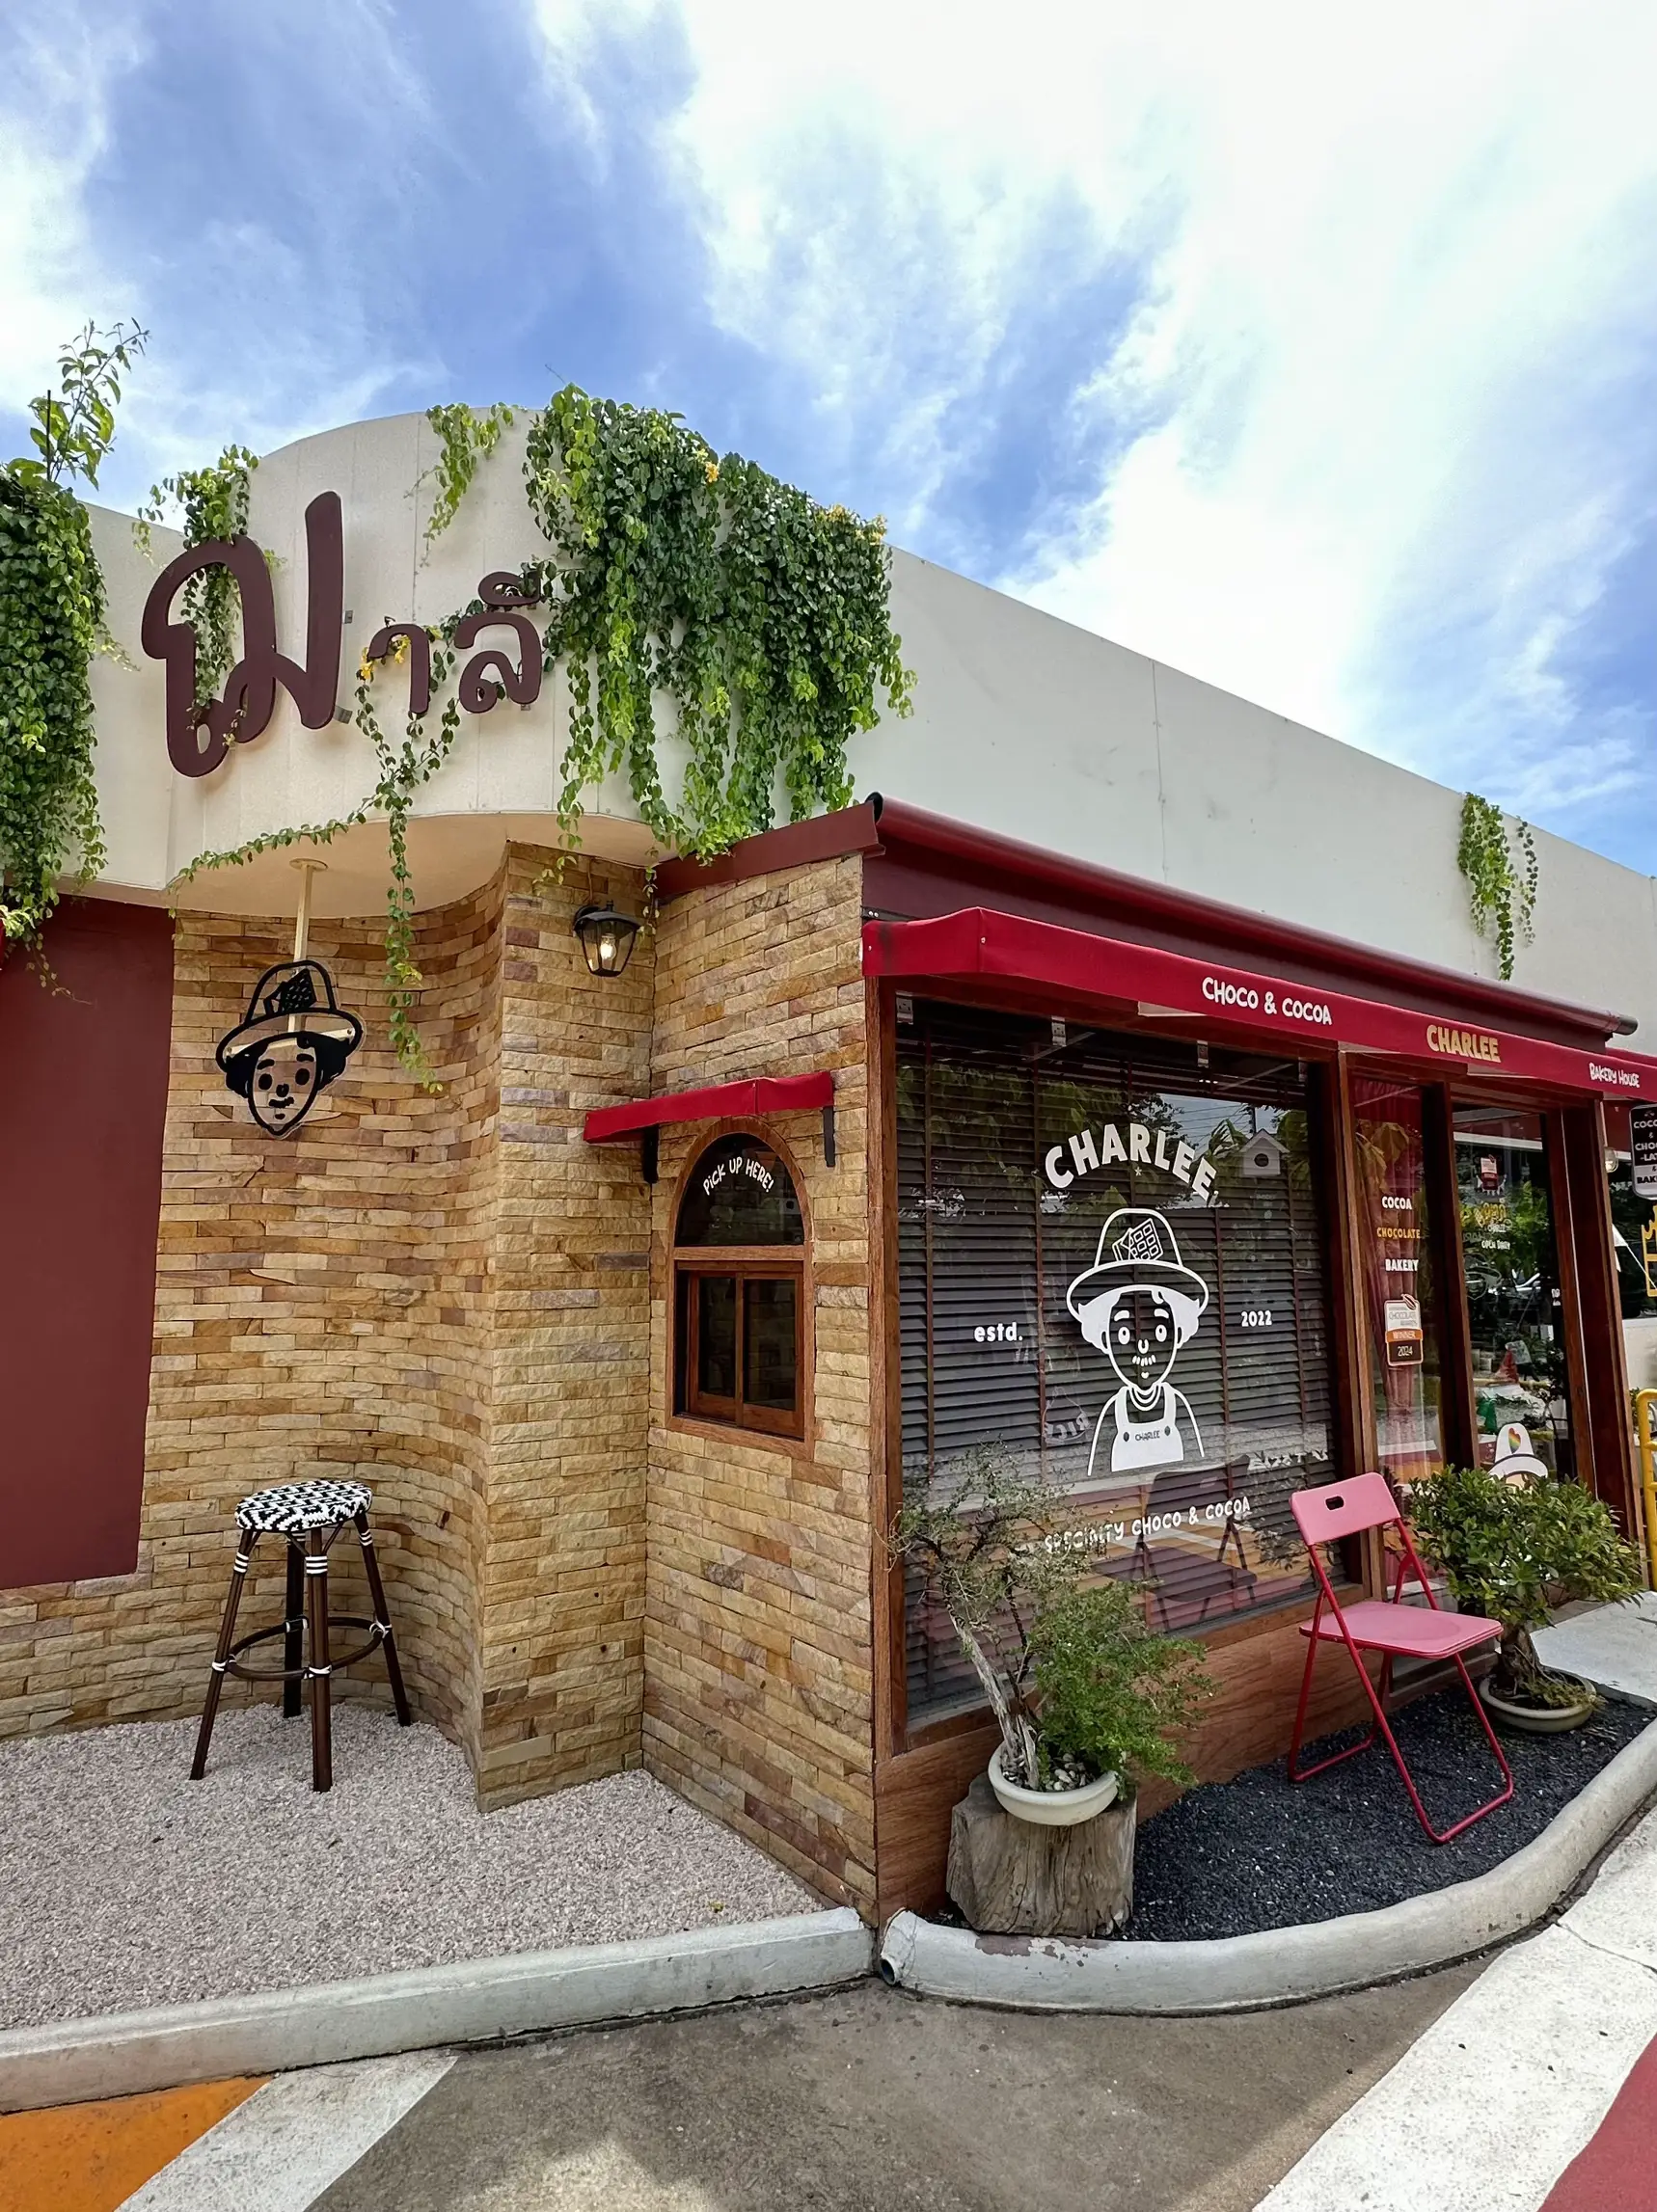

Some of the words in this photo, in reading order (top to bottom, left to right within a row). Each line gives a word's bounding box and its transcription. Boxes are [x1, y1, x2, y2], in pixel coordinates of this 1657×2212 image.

[1202, 977, 1259, 1010] CHOCO
[1263, 991, 1277, 1014] &
[1282, 997, 1332, 1026] COCOA
[1426, 1024, 1502, 1064] CHARLEE
[1589, 1062, 1617, 1084] BAKERY
[1617, 1069, 1641, 1088] HOUSE
[1045, 1122, 1217, 1201] CHARLEE
[729, 1156, 743, 1174] UP
[746, 1158, 774, 1193] HERE!
[1381, 1196, 1413, 1210] COCOA
[1376, 1227, 1421, 1239] CHOCOLATE
[1385, 1258, 1420, 1272] BAKERY
[1240, 1310, 1273, 1328] 2022
[973, 1322, 1024, 1342] estd.
[1397, 1345, 1414, 1357] 2024
[1134, 1430, 1160, 1442] CHARLEE
[1131, 1511, 1182, 1537] CHOCO
[1188, 1506, 1199, 1525] &
[1205, 1496, 1251, 1521] COCOA
